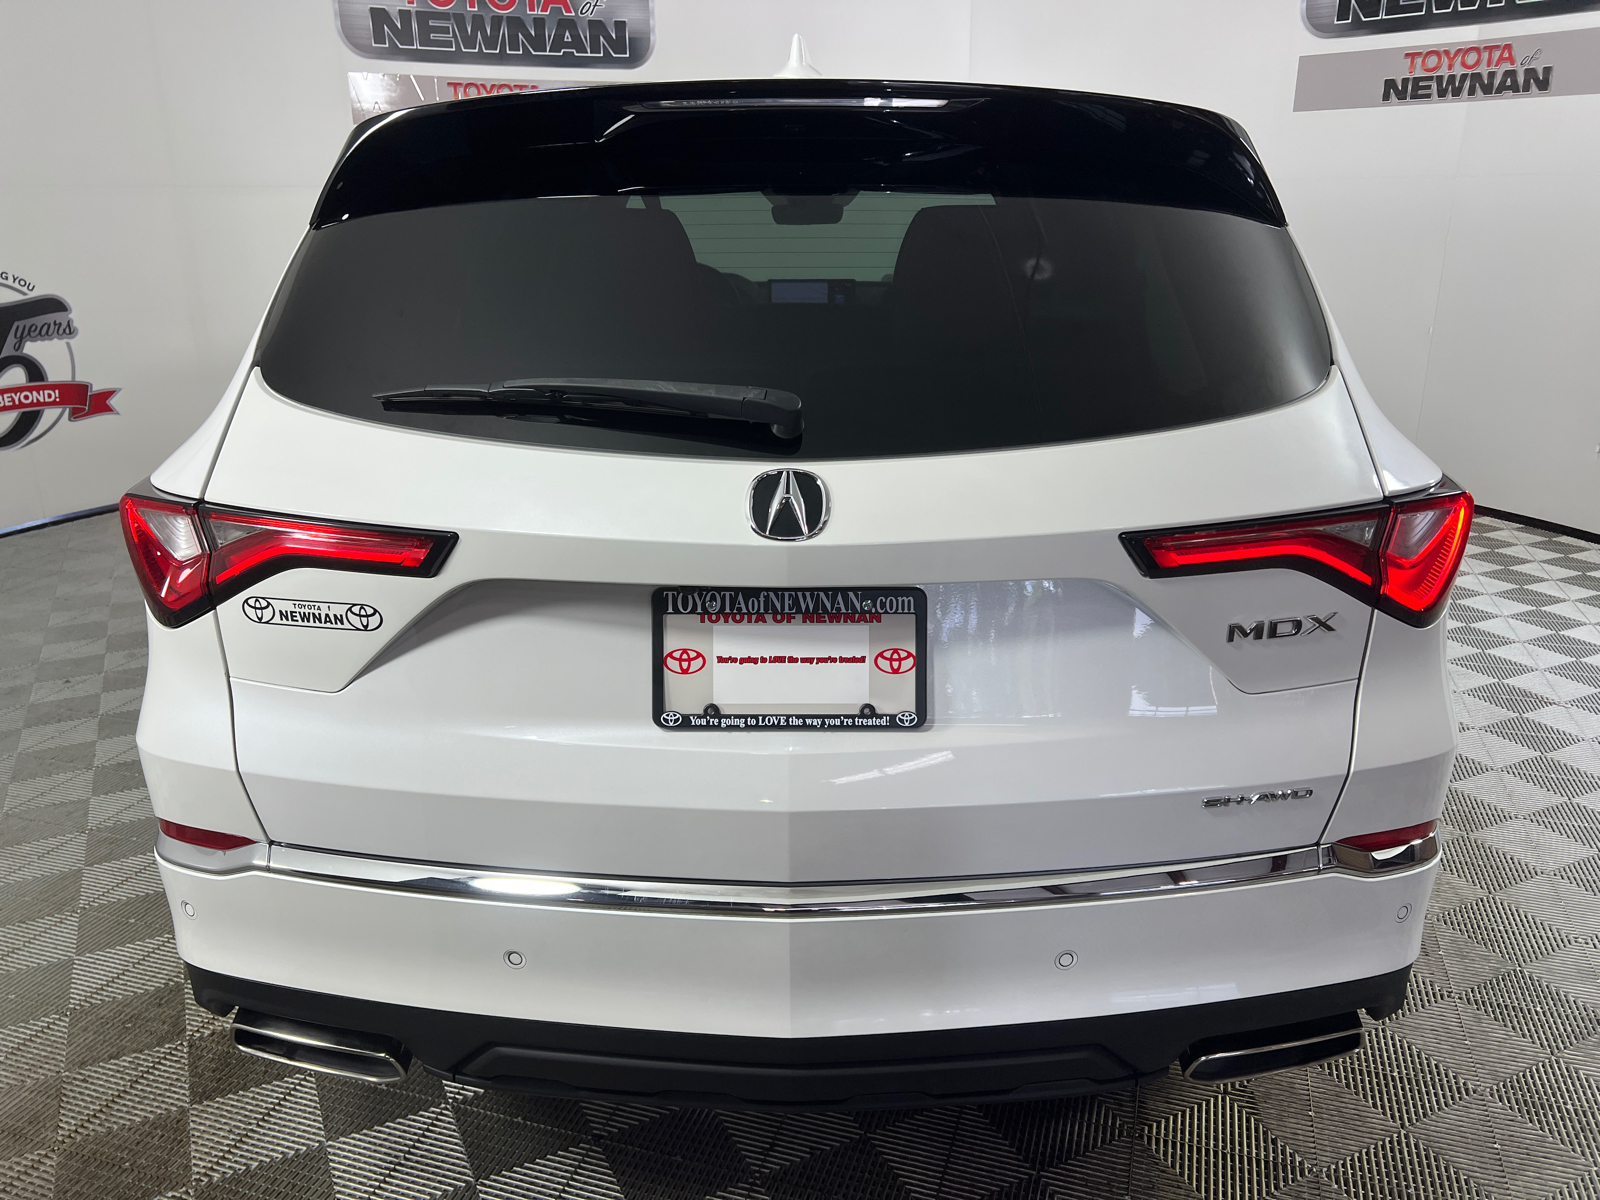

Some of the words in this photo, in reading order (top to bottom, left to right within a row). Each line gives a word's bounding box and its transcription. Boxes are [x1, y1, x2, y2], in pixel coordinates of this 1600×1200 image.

[369, 6, 629, 57] NEWNAN
[1404, 43, 1516, 74] TOYOTA
[1520, 48, 1542, 67] of
[1382, 66, 1553, 102] NEWNAN
[12, 274, 35, 292] YOU
[14, 319, 75, 352] years
[278, 609, 345, 626] NEWNAN
[292, 603, 322, 612] TOYOTA
[699, 613, 767, 624] TOYOTA
[772, 613, 796, 624] OF
[802, 613, 882, 624] NEWNAN
[1226, 611, 1338, 643] MDX
[690, 716, 719, 726] You're
[721, 716, 745, 728] going
[747, 717, 756, 726] to
[758, 716, 787, 726] LOVE
[789, 716, 804, 726] the
[805, 718, 823, 728] way
[824, 716, 853, 728] you're
[854, 716, 890, 726] treated!
